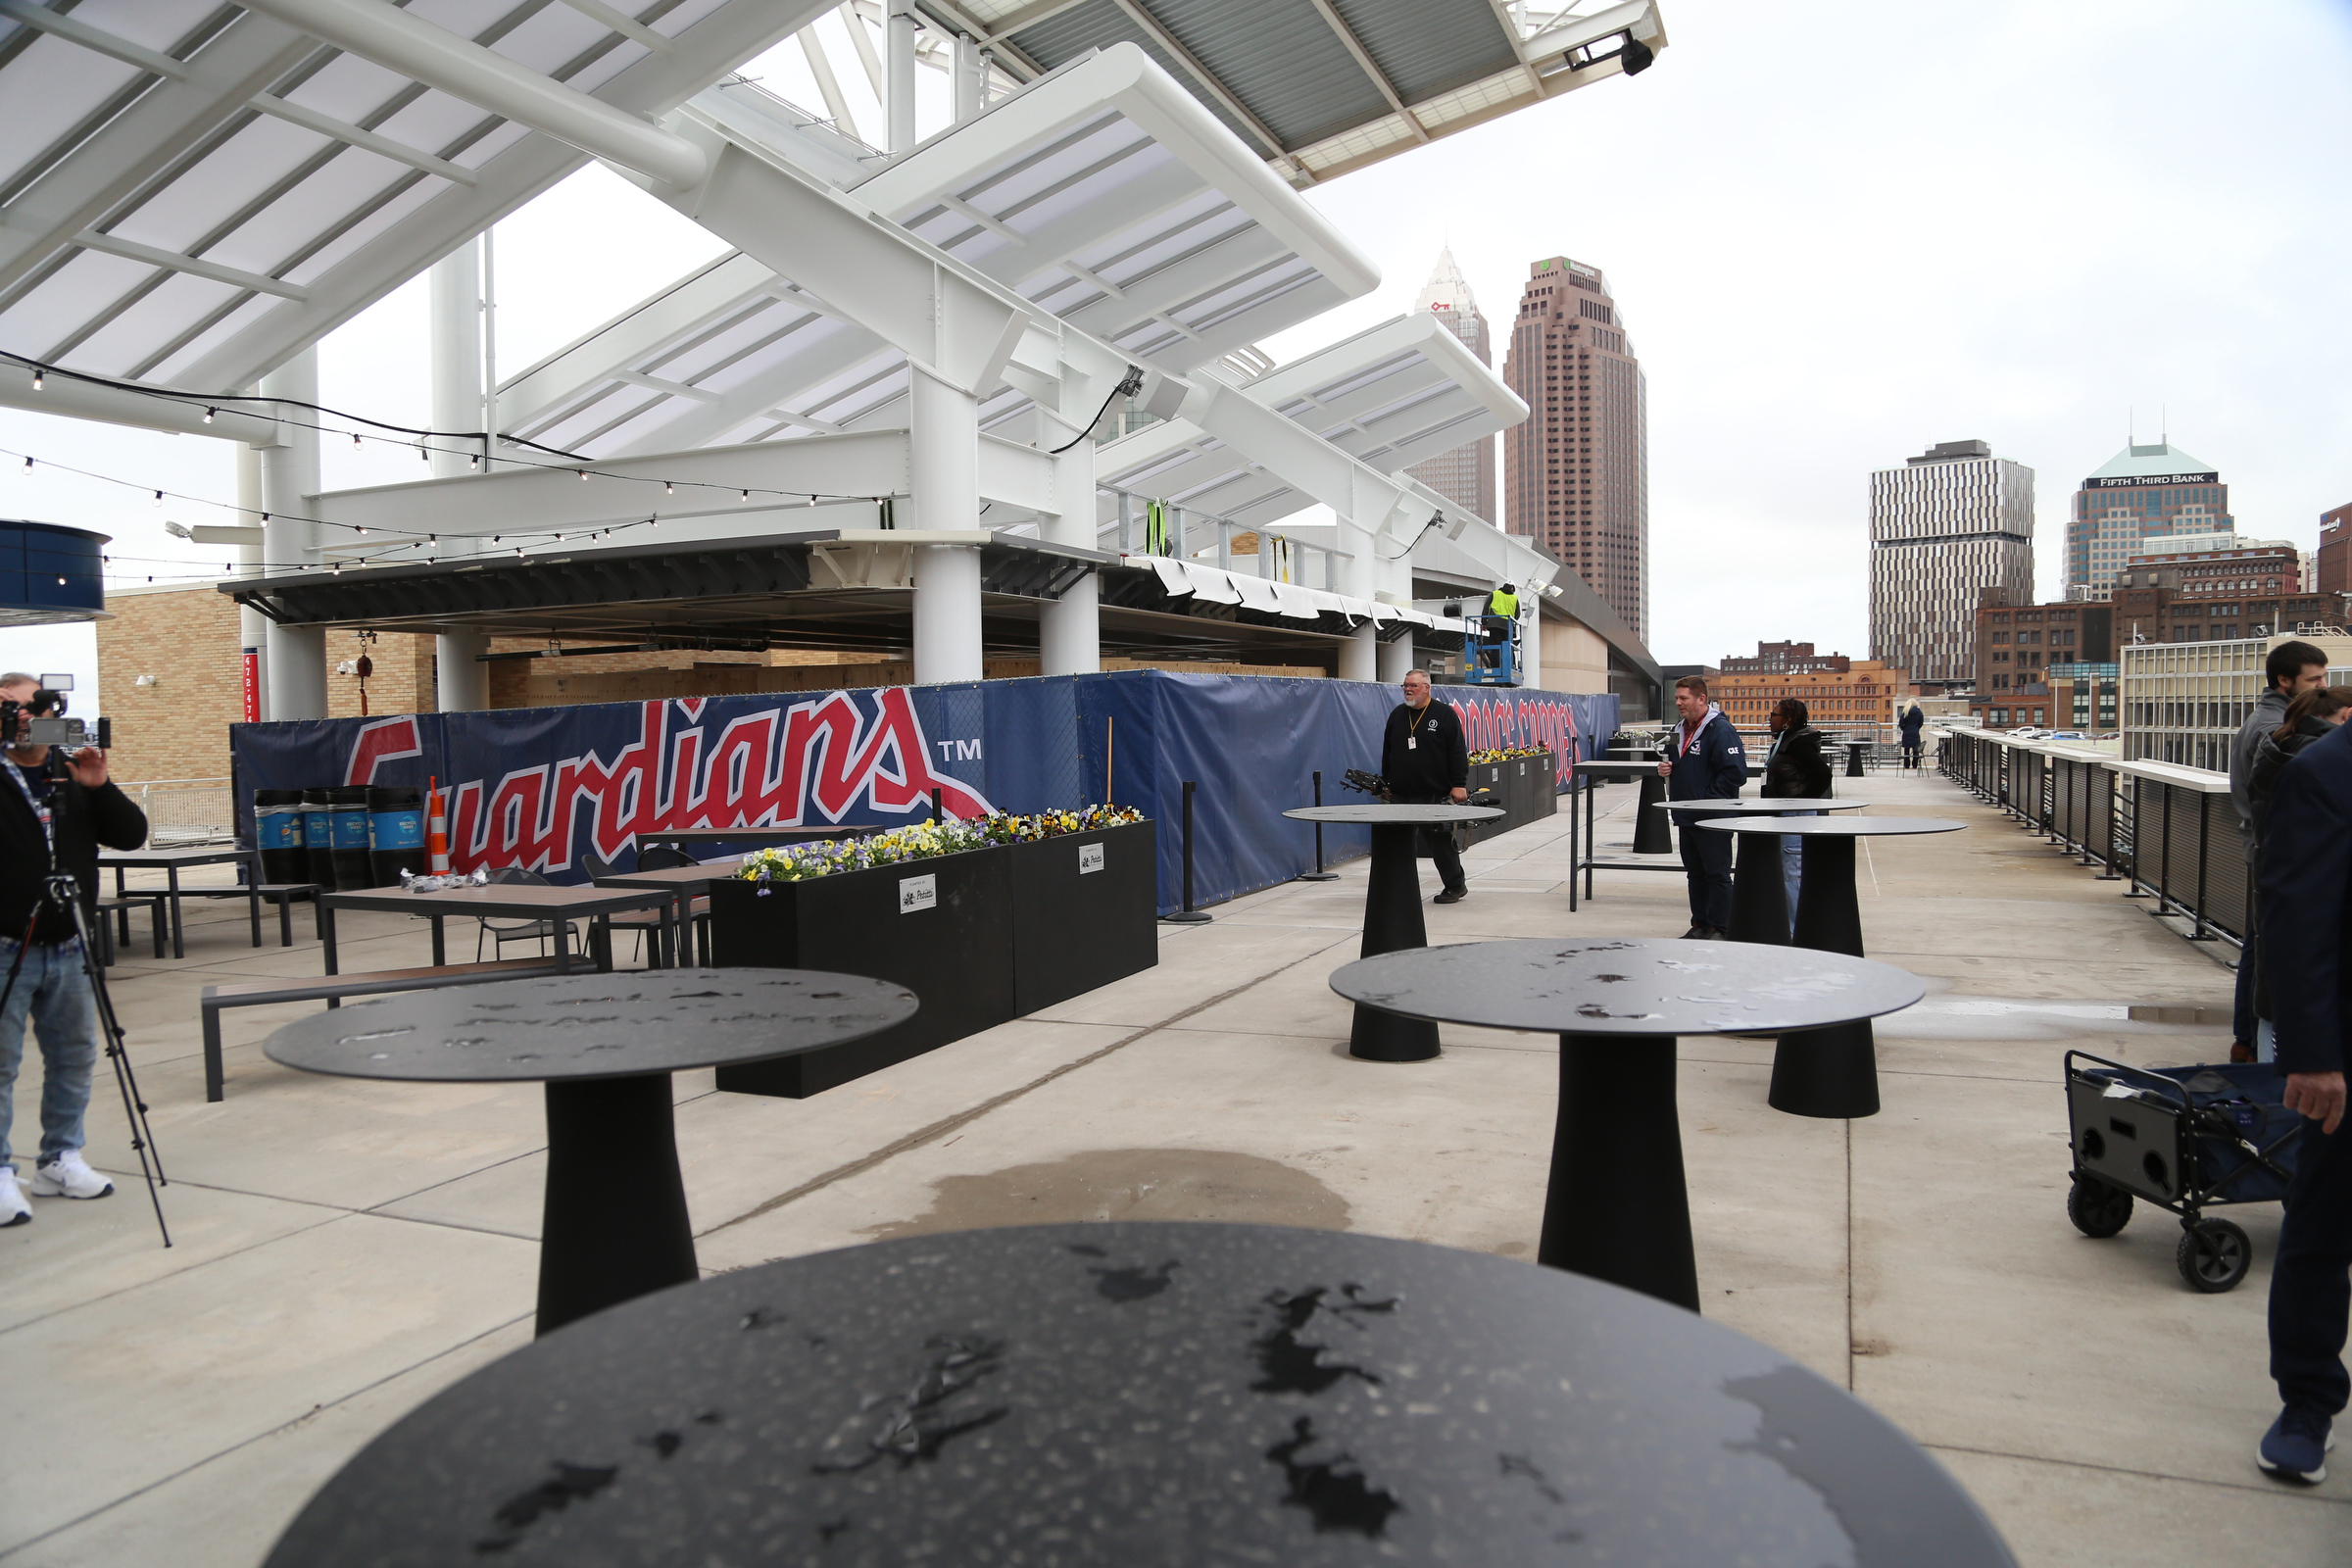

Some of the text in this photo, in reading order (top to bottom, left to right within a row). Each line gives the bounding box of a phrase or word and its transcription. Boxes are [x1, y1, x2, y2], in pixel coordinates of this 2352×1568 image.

[1569, 260, 1595, 277] Huntington
[2100, 474, 2205, 487] FIFTH THIRD BANK
[937, 738, 982, 762] TM
[1727, 746, 1740, 755] CLE
